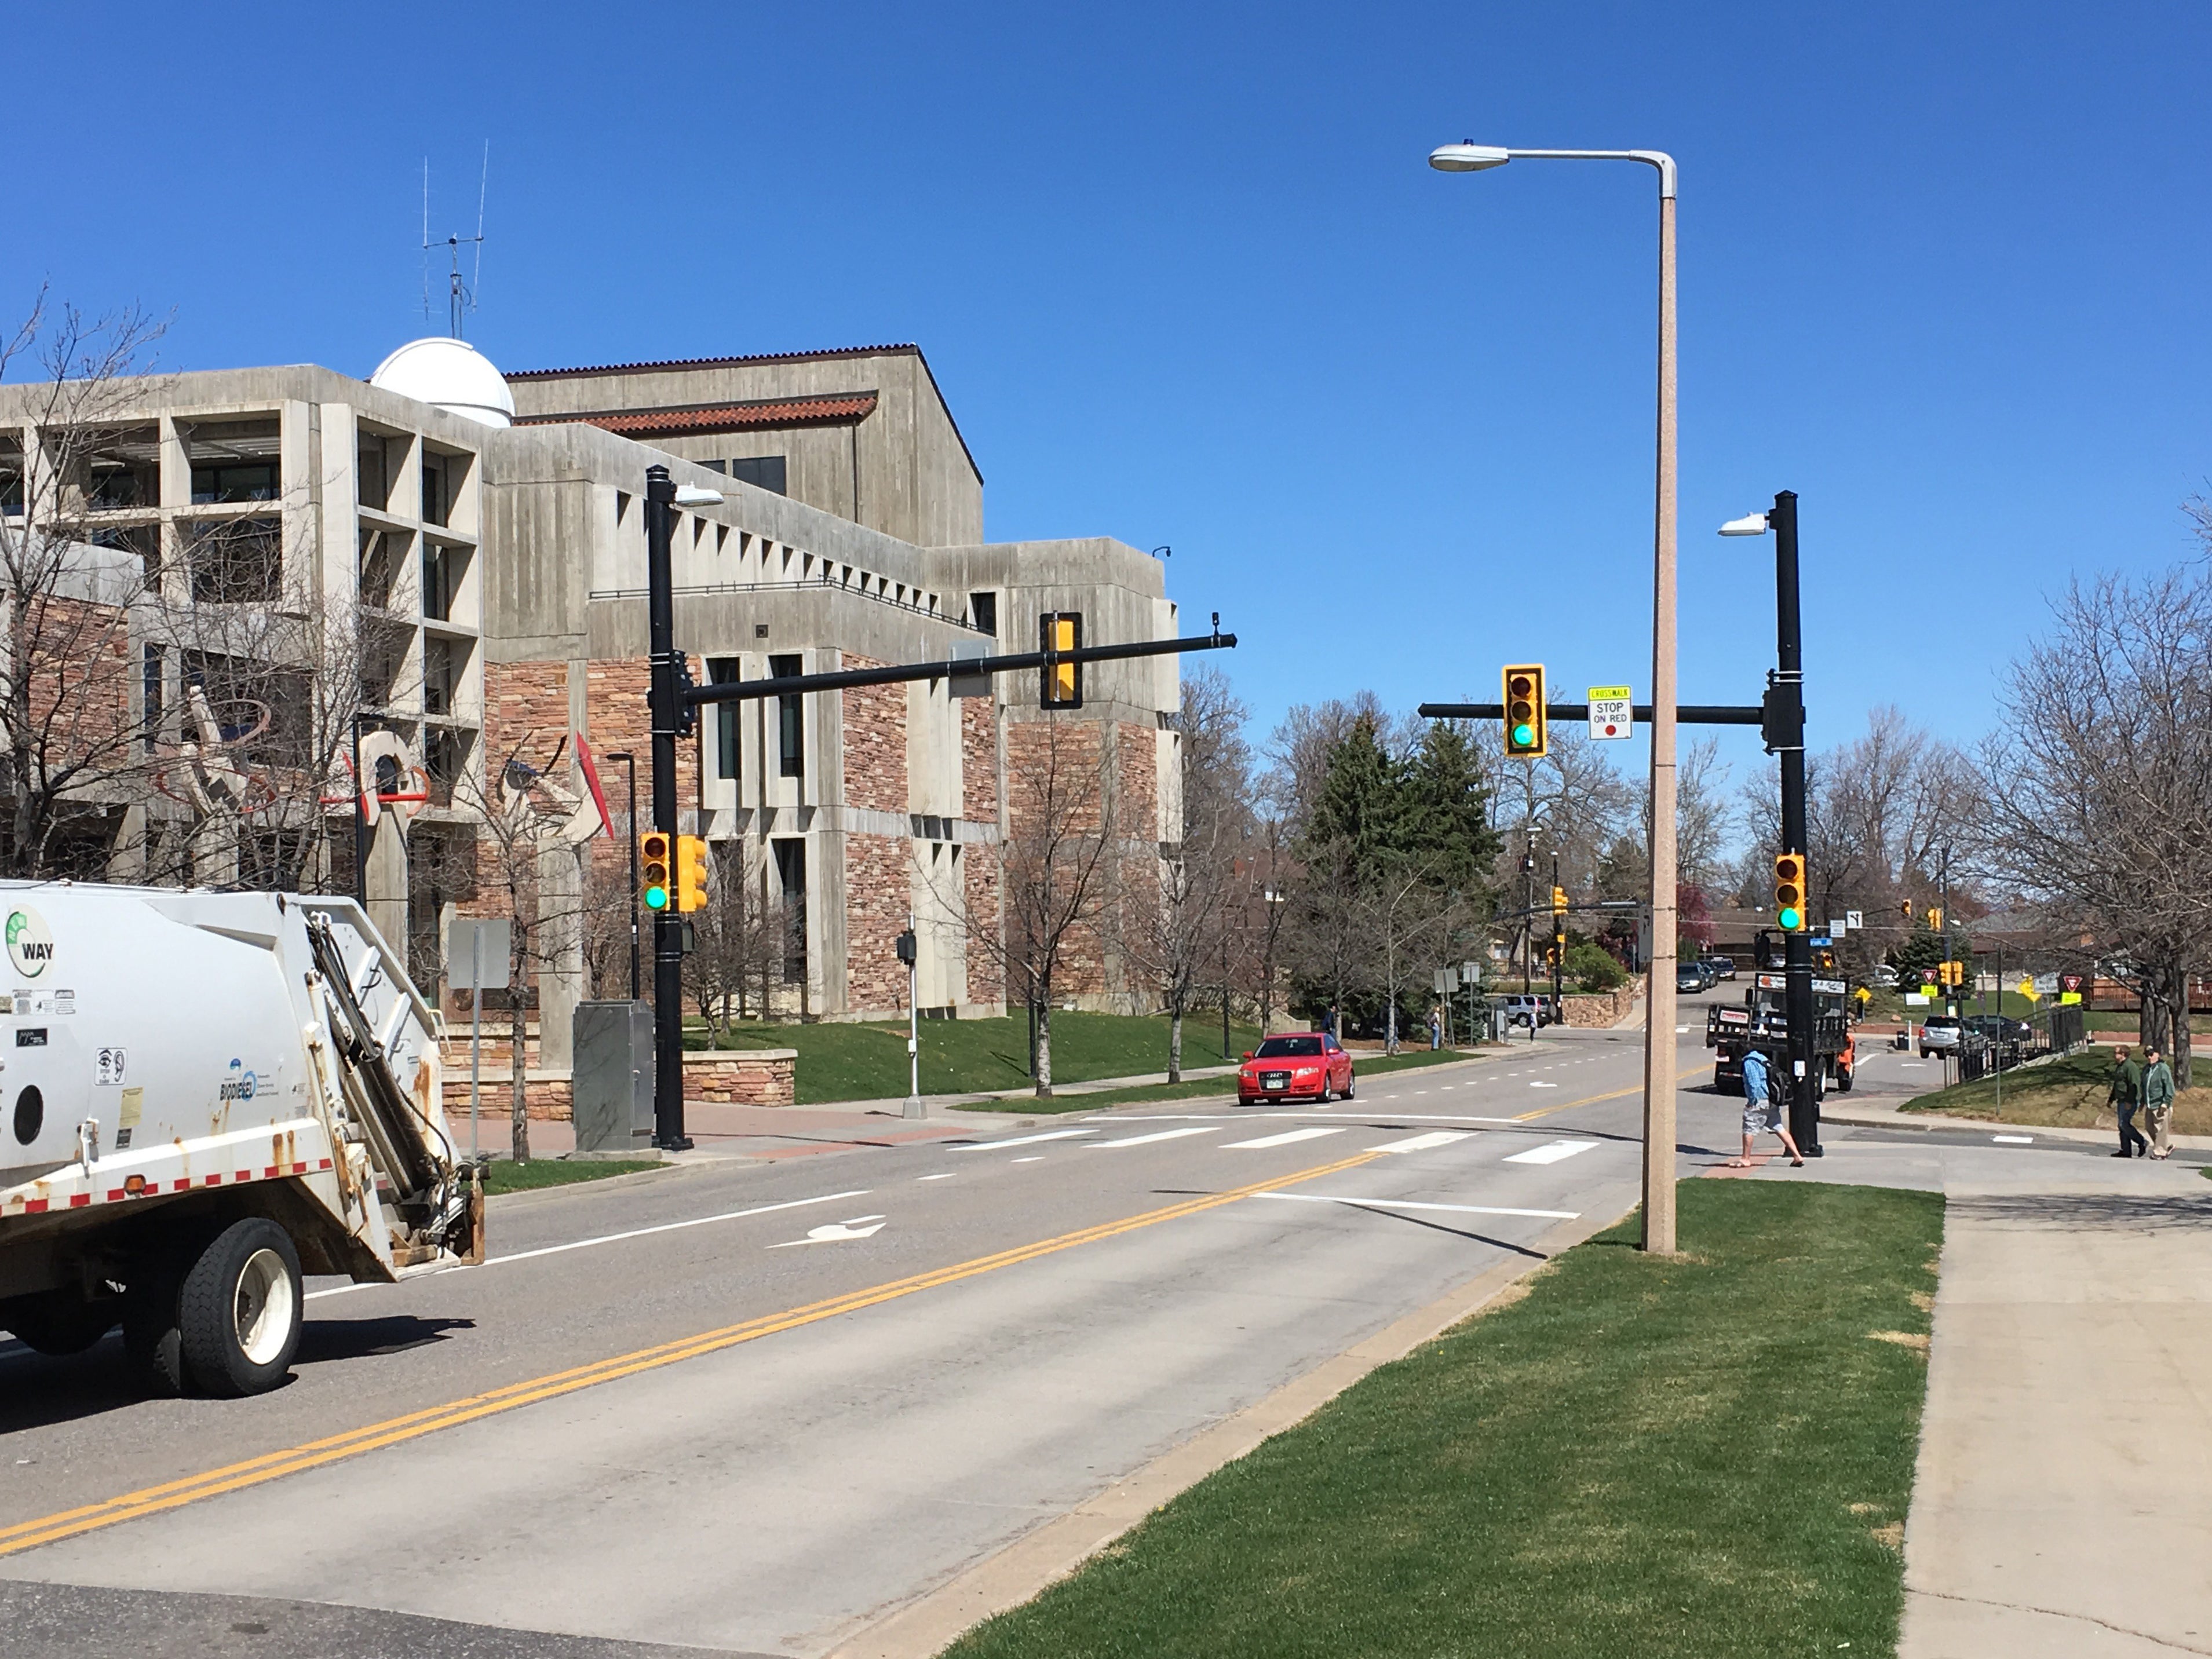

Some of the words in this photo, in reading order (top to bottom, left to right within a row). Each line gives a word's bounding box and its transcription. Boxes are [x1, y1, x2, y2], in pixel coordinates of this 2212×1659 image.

[1592, 689, 1627, 698] CROSSWALK
[1597, 702, 1624, 713] STOP
[1594, 715, 1606, 723] ON
[1609, 714, 1627, 722] RED
[8, 915, 25, 941] NEW
[22, 943, 53, 960] WAY
[220, 1081, 253, 1101] BIODIESEL
